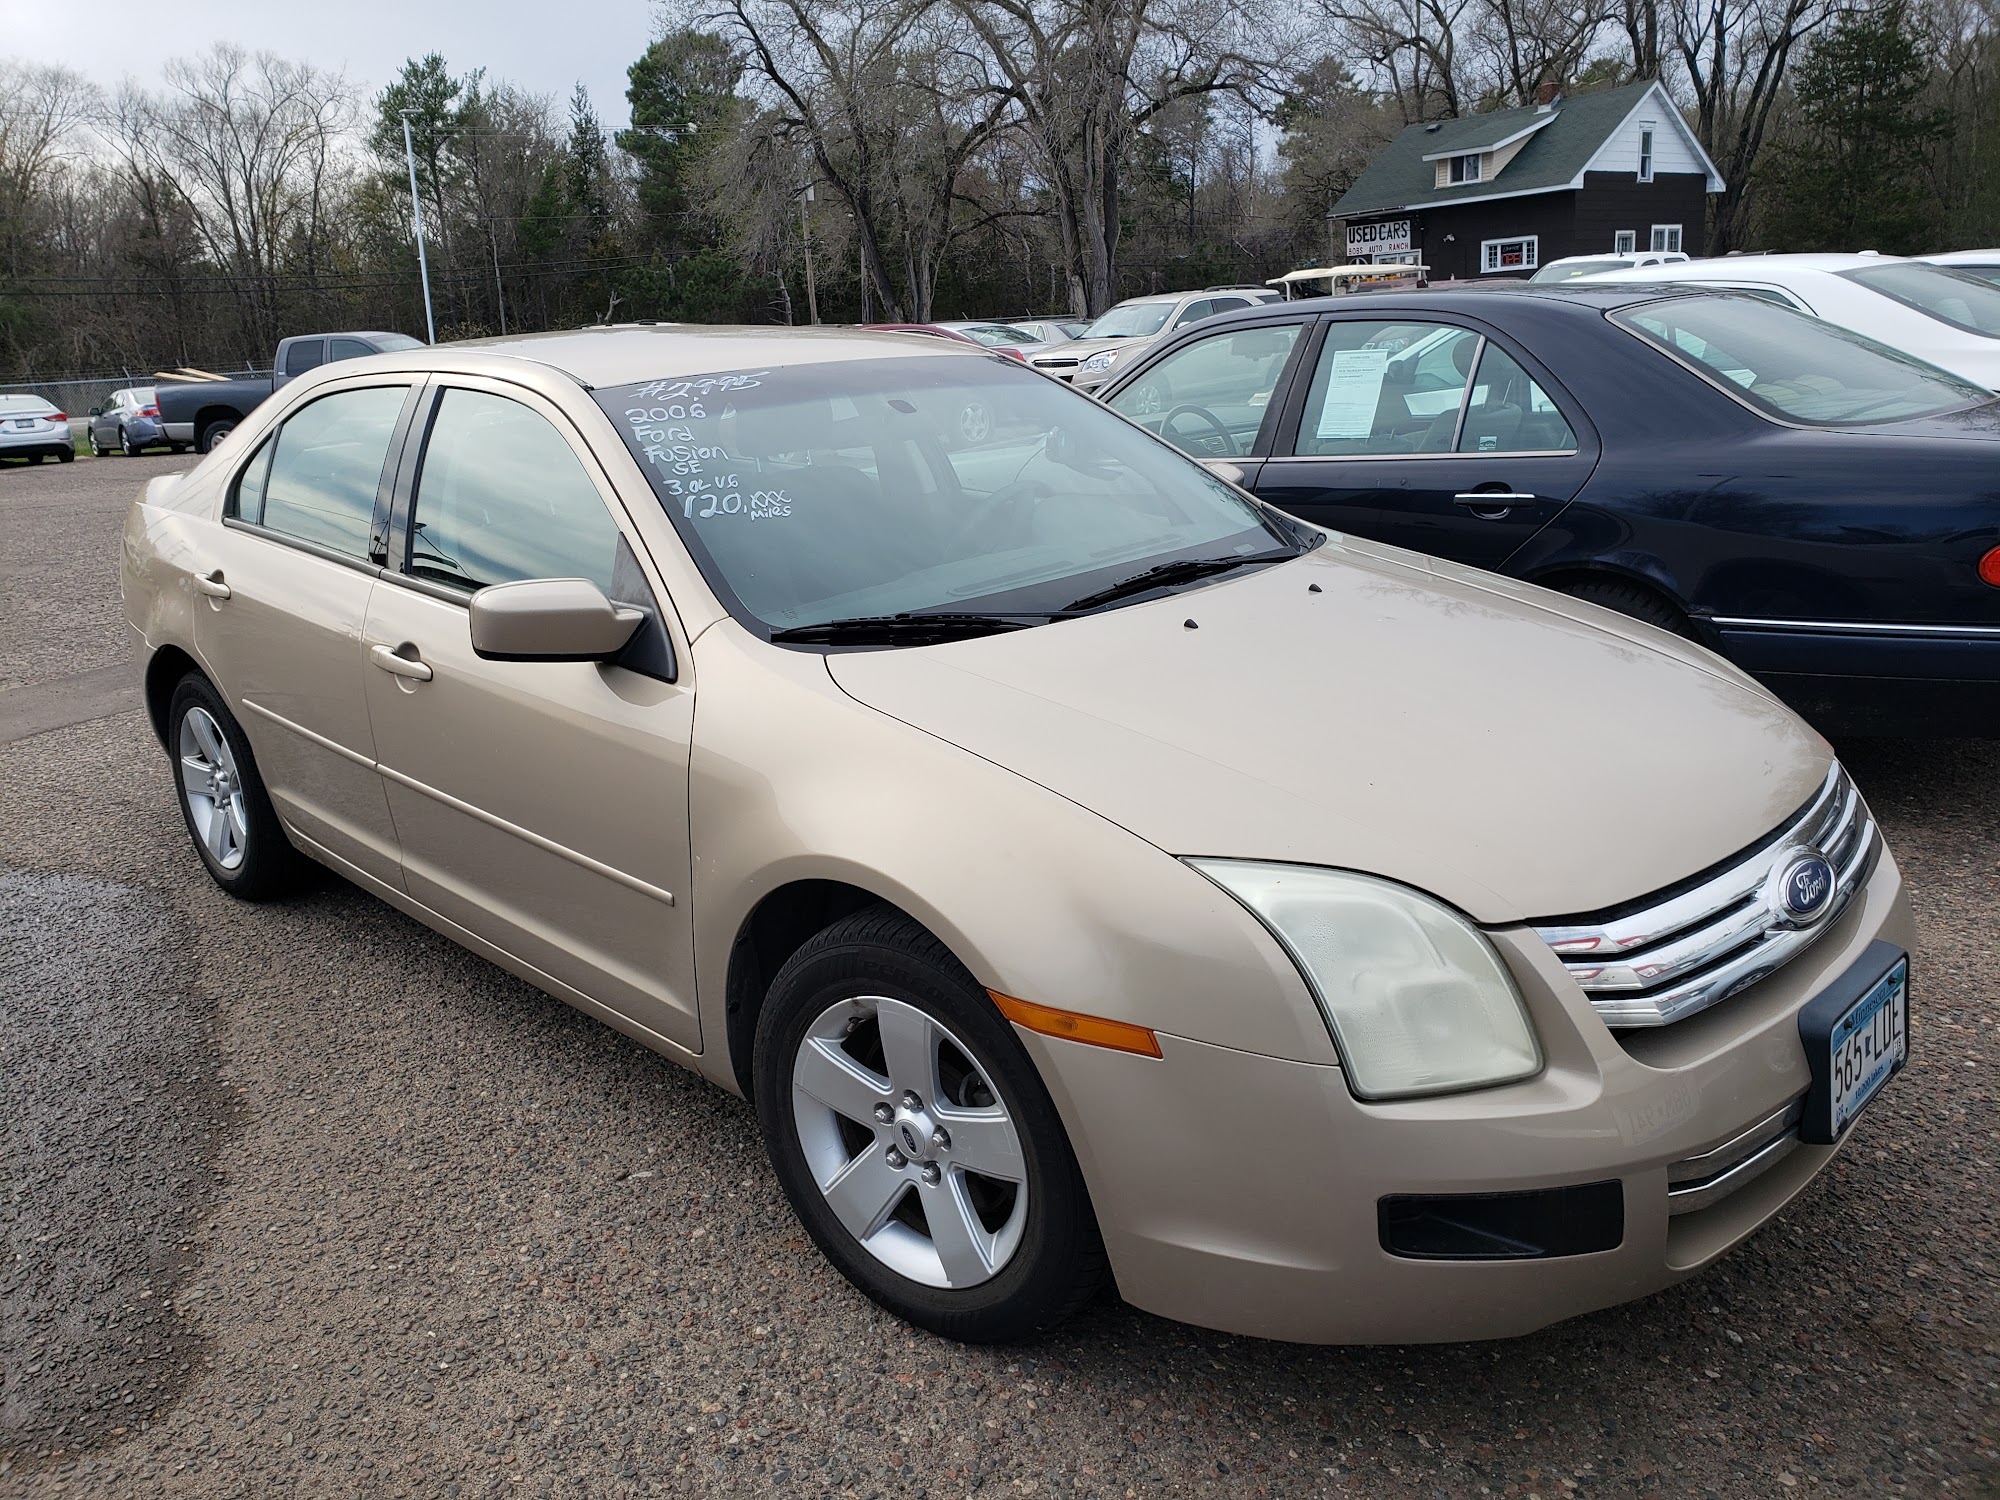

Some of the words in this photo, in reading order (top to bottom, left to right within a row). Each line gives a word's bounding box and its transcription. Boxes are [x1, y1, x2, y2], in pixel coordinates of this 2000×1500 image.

[1349, 225, 1377, 243] USED
[1379, 222, 1408, 240] CARS
[625, 404, 706, 423] 2006
[632, 425, 695, 442] Ford
[672, 460, 703, 475] SE
[1796, 867, 1827, 905] Ford
[1834, 1027, 1863, 1104] 565
